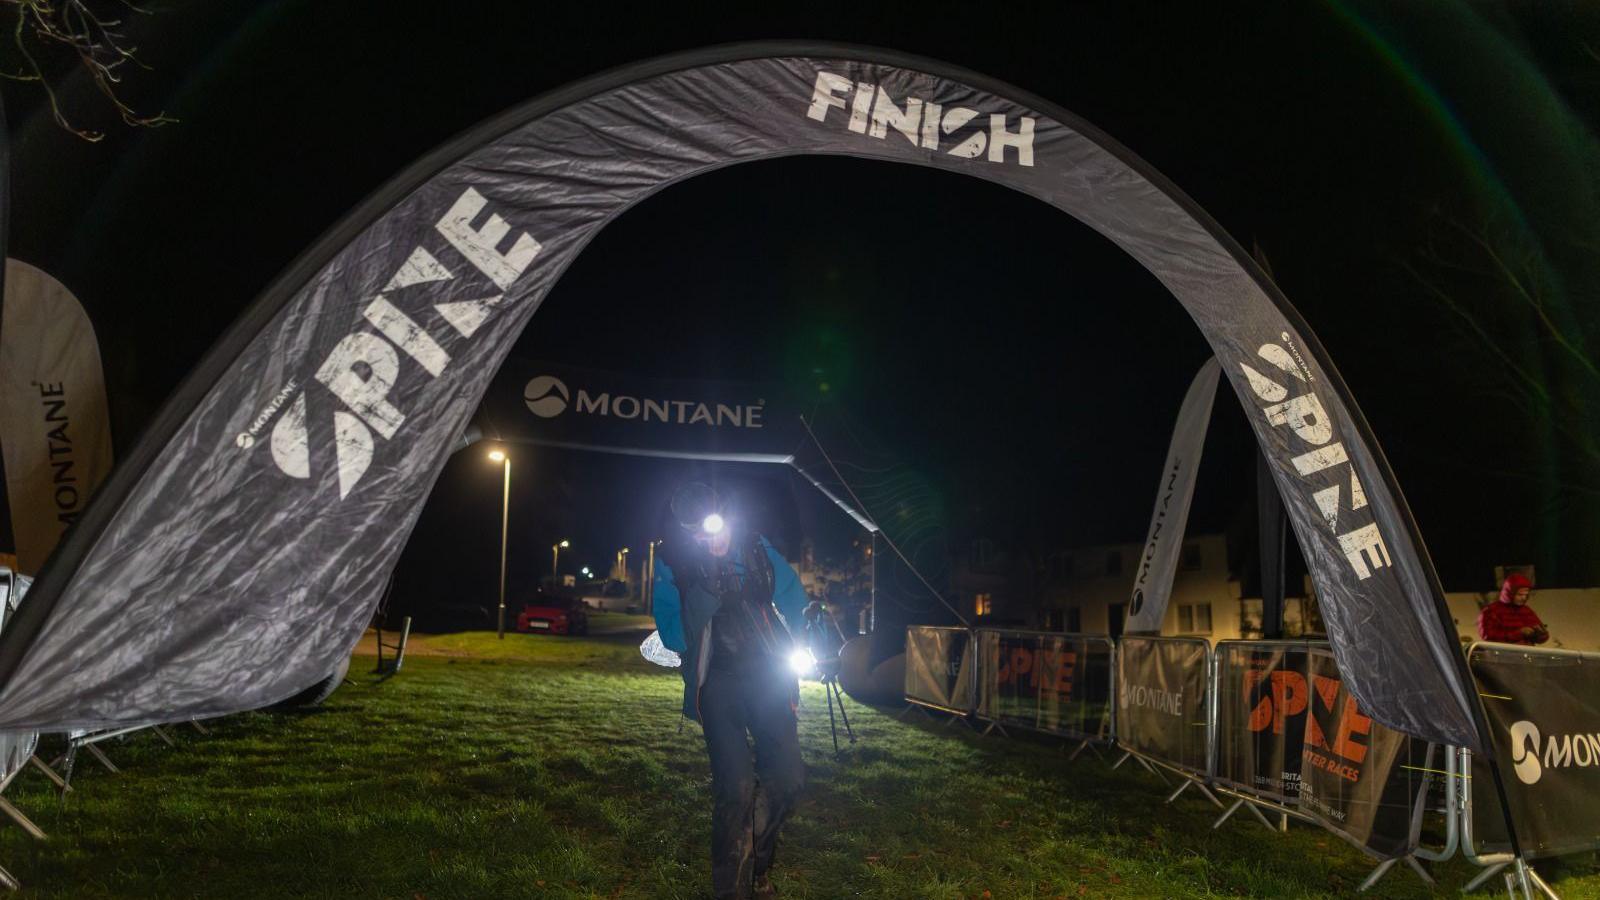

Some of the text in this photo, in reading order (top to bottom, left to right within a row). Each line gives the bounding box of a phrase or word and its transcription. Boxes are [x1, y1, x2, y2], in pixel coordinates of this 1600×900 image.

[806, 71, 1036, 167] FINISH
[270, 186, 543, 501] SPINE
[249, 379, 297, 436] MONTANE
[575, 388, 765, 429] MONTANE
[1240, 343, 1393, 581] SPINE
[1140, 457, 1182, 584] MONTANE
[1126, 684, 1183, 717] MONTANE
[1327, 759, 1360, 783] RACES
